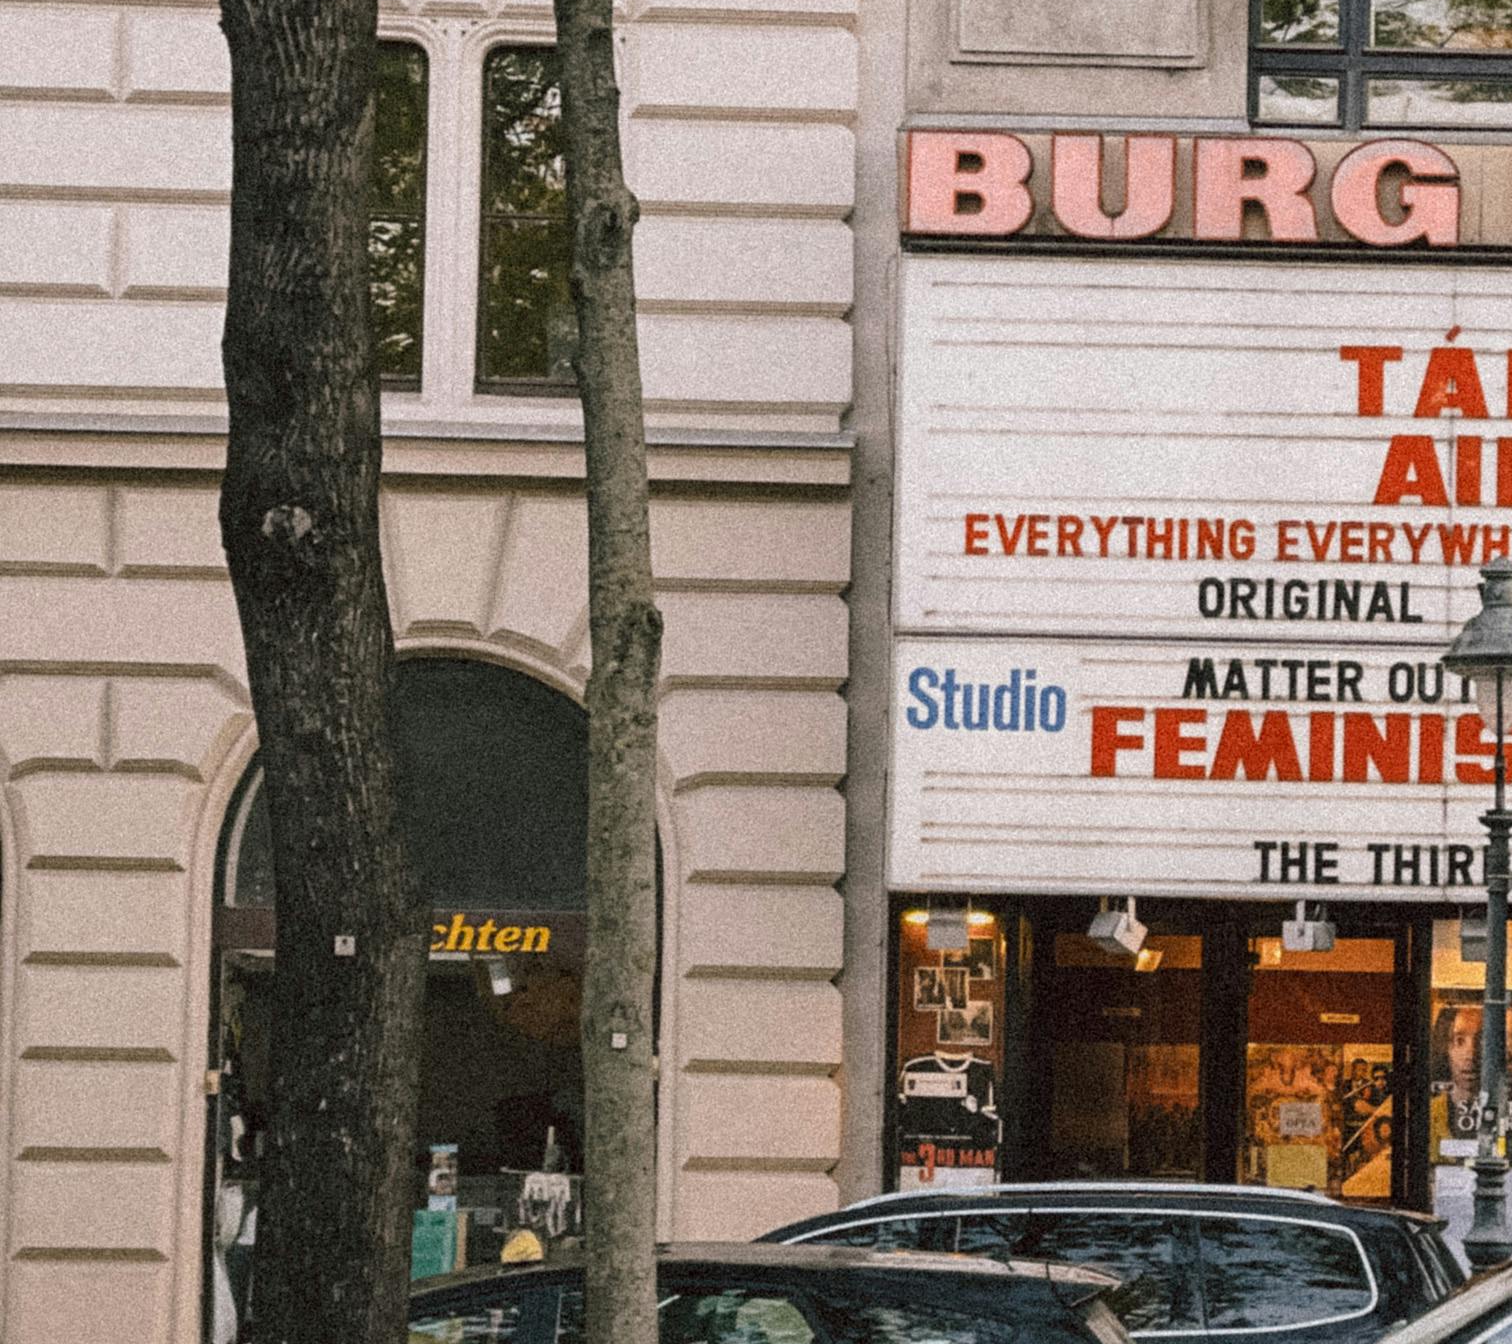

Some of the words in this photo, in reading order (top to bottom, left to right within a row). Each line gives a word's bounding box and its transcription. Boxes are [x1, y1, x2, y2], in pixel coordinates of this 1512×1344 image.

[907, 130, 1461, 247] BURG
[963, 513, 1256, 561] EVERYTHING
[1199, 577, 1423, 623] ORIGINAL
[906, 666, 1067, 732] Studio
[1182, 658, 1363, 701] MATTER
[1254, 841, 1338, 884] THE
[1367, 842, 1492, 887] THIR
[430, 912, 552, 953] chten
